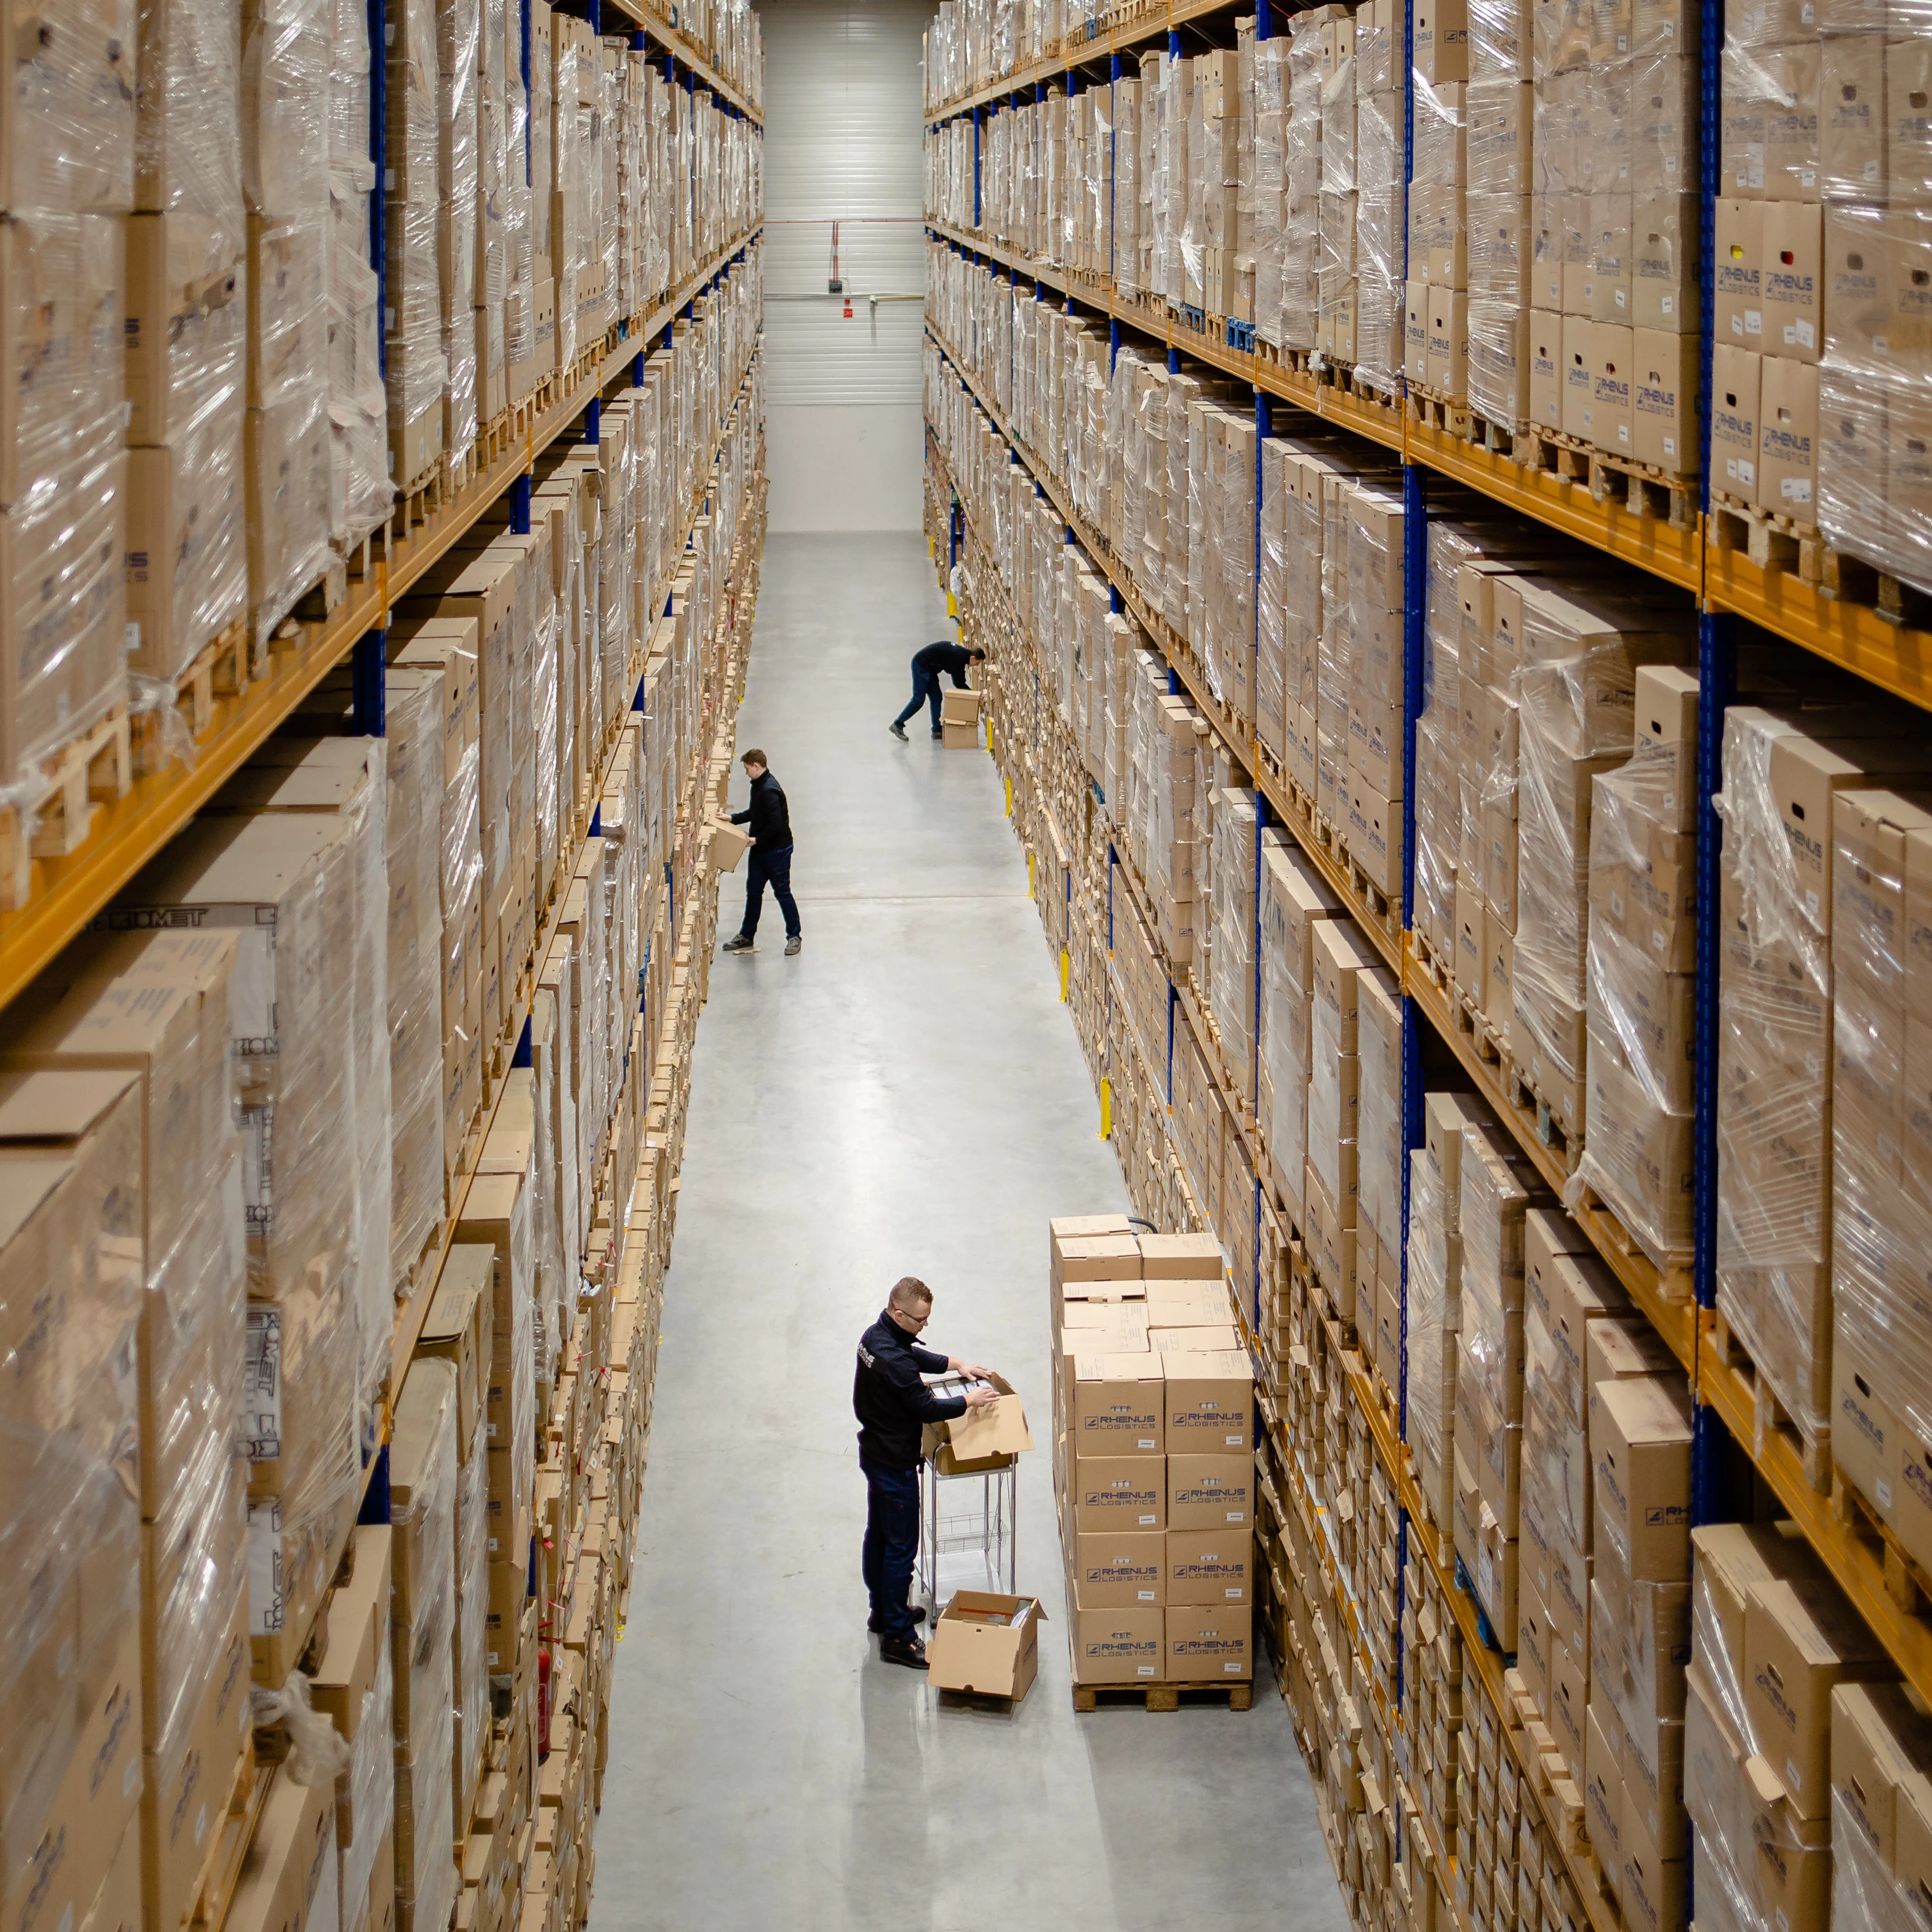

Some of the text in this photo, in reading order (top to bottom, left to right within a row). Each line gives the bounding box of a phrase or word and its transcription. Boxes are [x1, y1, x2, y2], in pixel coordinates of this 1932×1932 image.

[1418, 31, 1432, 41] RHENUS
[1725, 266, 1760, 283] RHENUS
[1774, 273, 1813, 291] RHENUS
[1409, 327, 1424, 338] RHENUS
[1433, 337, 1449, 349] RHENUS
[1602, 378, 1628, 395] RHENUS
[1644, 388, 1674, 405] RHENUS
[1720, 413, 1752, 435] RHENUS
[1772, 429, 1810, 452] RHENUS
[1784, 821, 1822, 859] RHENUS
[1100, 1415, 1155, 1423] RHENUS
[1101, 1491, 1156, 1499] RHENUS
[1191, 1488, 1245, 1497] RHENUS
[1102, 1567, 1157, 1575] RHENUS
[1102, 1641, 1156, 1650] RHENUS
[1189, 1640, 1243, 1648] RHENUS
